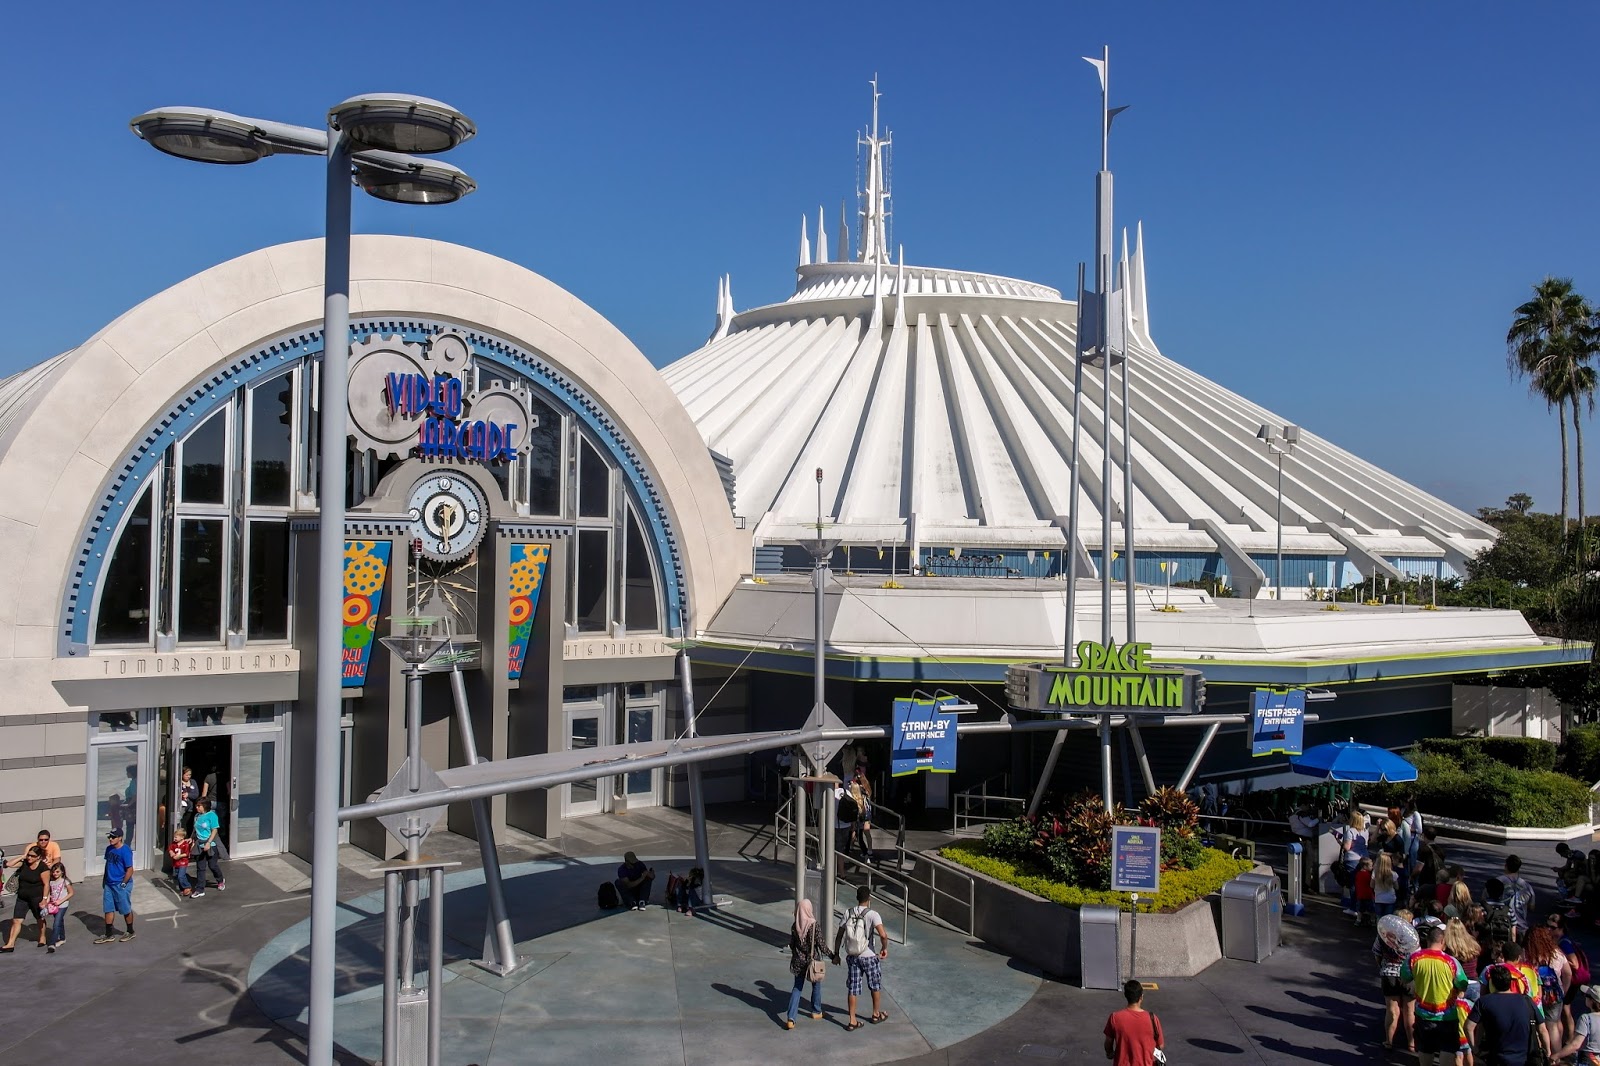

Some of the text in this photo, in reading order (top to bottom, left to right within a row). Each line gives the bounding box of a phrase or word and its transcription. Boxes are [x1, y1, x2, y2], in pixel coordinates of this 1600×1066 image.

[385, 372, 461, 420] VIDEO
[420, 417, 517, 461] ARCADE
[342, 648, 363, 662] DEO
[603, 643, 643, 655] POWER
[1076, 637, 1152, 672] SPACE
[103, 654, 291, 675] TOMORROWLAND
[1049, 674, 1183, 707] MOUNTAIN
[1257, 708, 1302, 718] FASTPASS+
[901, 719, 951, 732] STAND-BY
[1264, 717, 1295, 725] ENTRANCE
[906, 730, 946, 740] ENTRANCE
